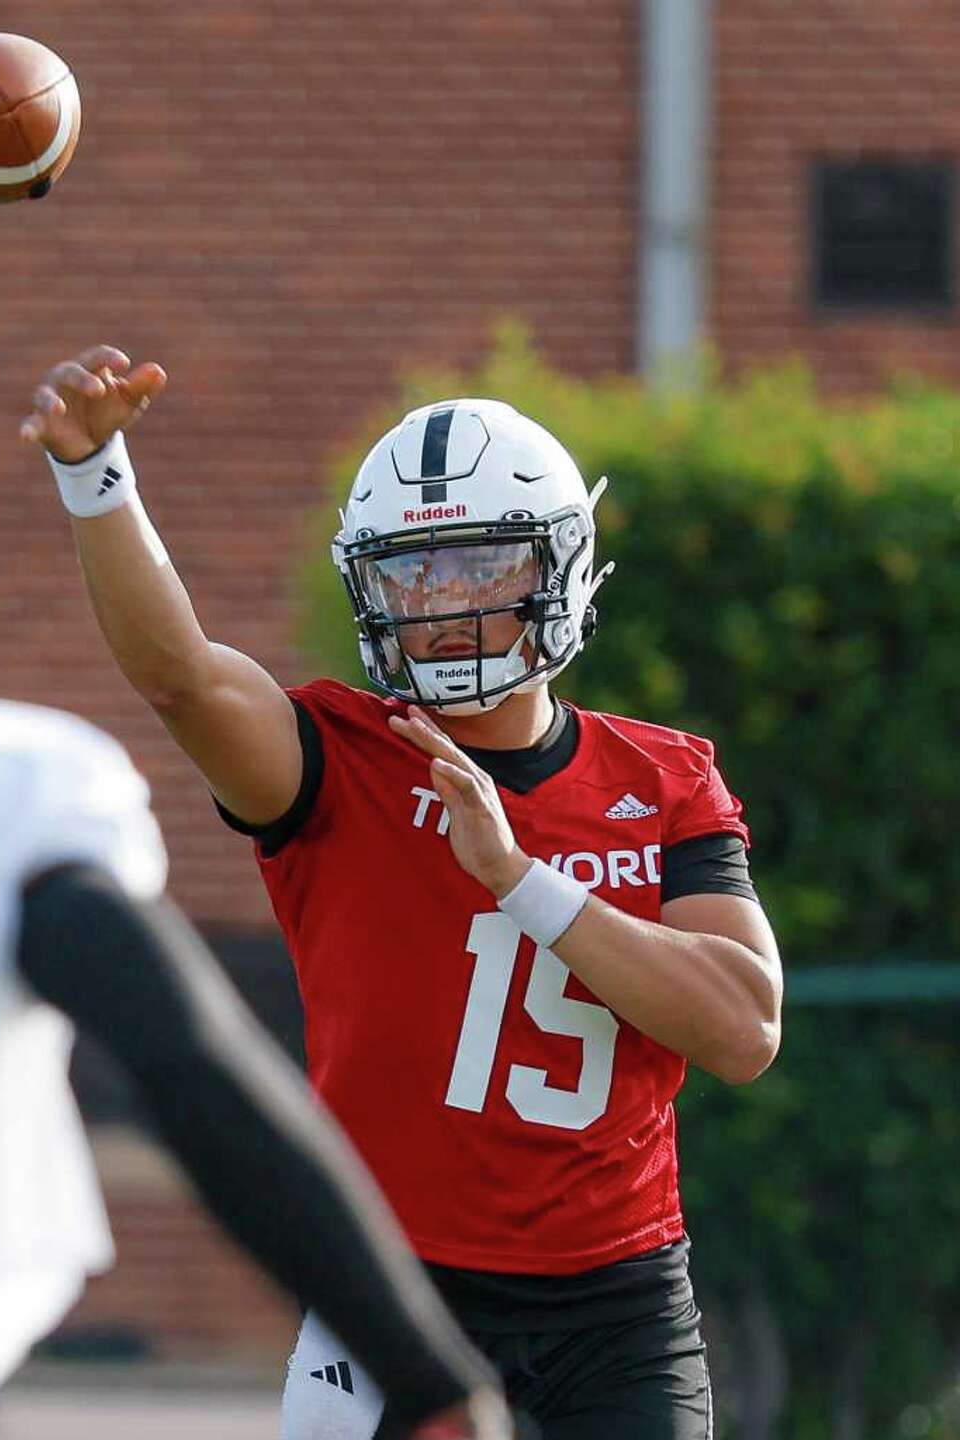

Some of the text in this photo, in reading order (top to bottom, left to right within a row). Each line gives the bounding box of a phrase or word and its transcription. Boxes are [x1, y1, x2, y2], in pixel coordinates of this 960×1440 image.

[403, 504, 467, 523] Riddell
[604, 804, 659, 820] adidas
[445, 911, 619, 1131] 15
